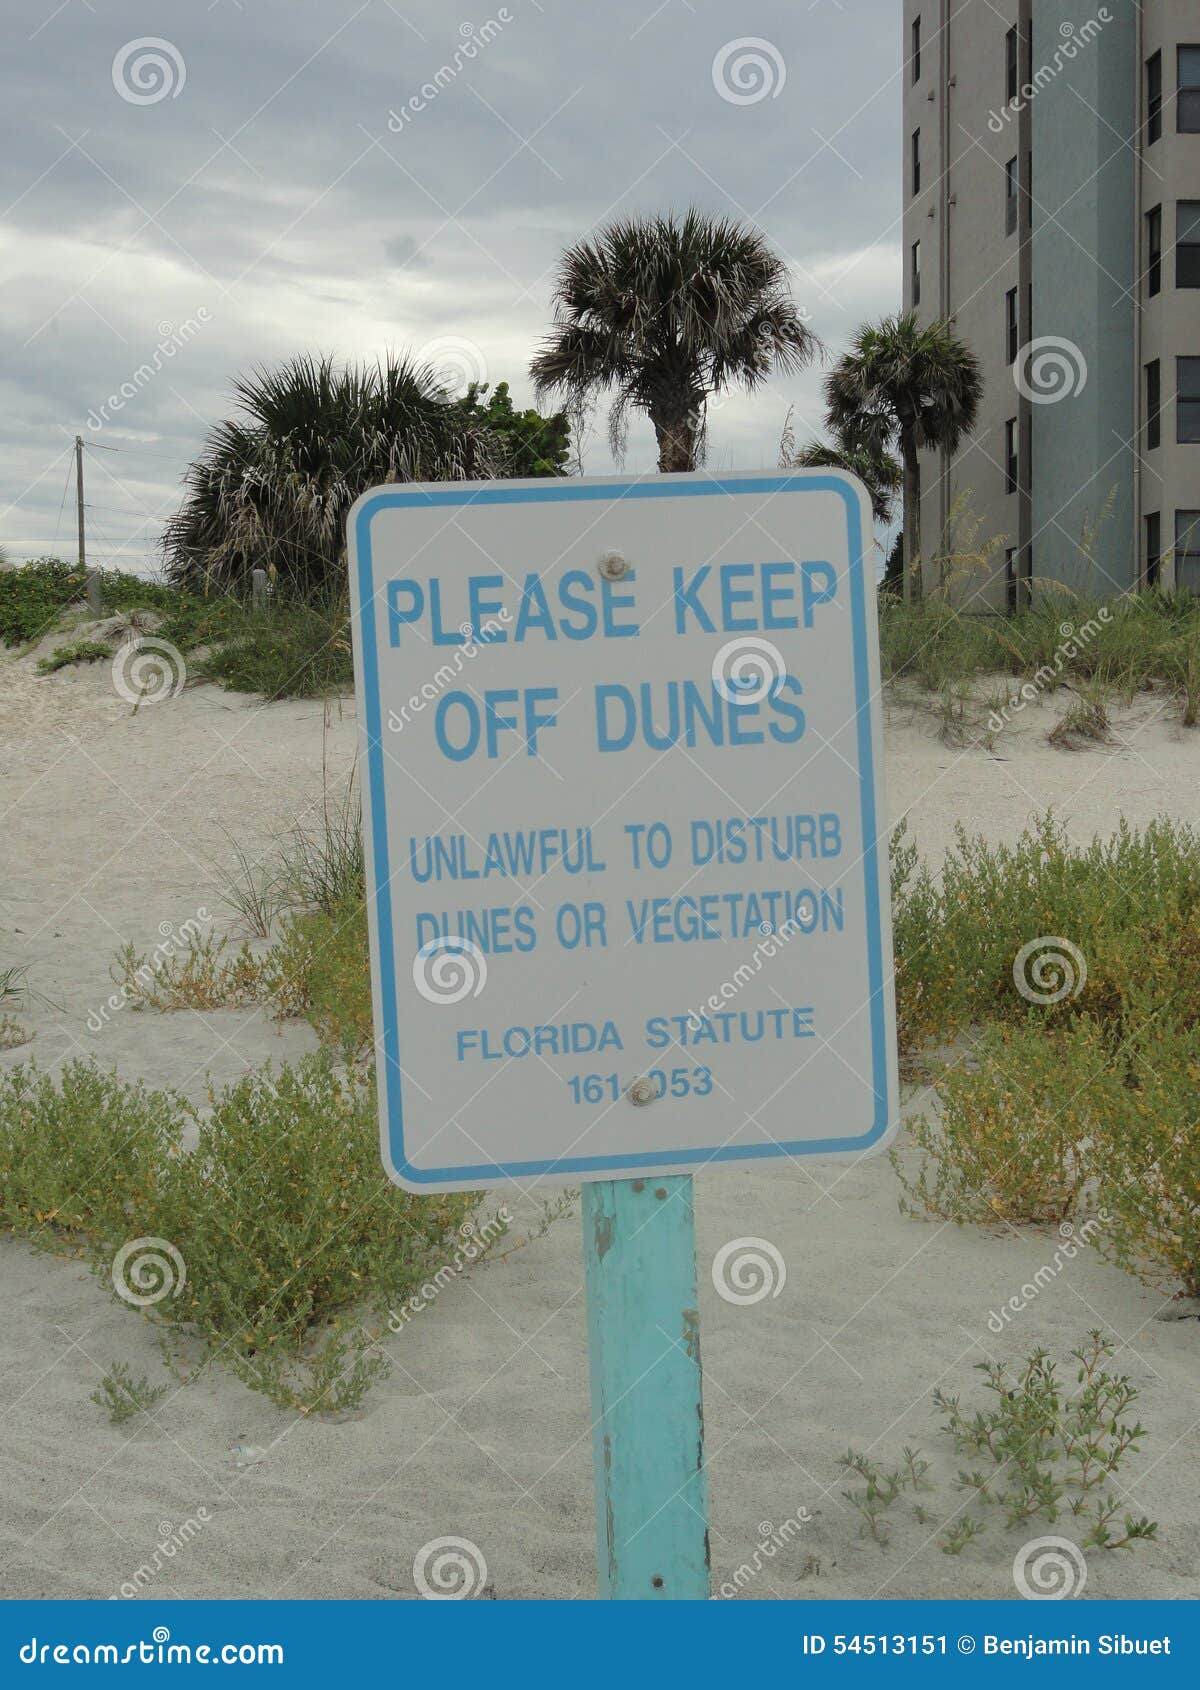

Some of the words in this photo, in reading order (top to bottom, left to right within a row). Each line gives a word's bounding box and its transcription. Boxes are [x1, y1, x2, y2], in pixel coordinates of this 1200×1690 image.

[386, 569, 640, 649] PLEASE
[673, 560, 838, 636] KEEP
[433, 687, 559, 762] OFF
[594, 674, 806, 752] DUNES
[409, 827, 606, 884] UNLAWFUL
[624, 822, 672, 869] TO
[690, 812, 843, 866] DISTURB
[416, 905, 537, 959] DUNES
[556, 902, 608, 950] OR
[626, 888, 844, 944] VEGETATION
[456, 1020, 624, 1062] FLORIDA
[646, 1007, 816, 1049] STATUTE
